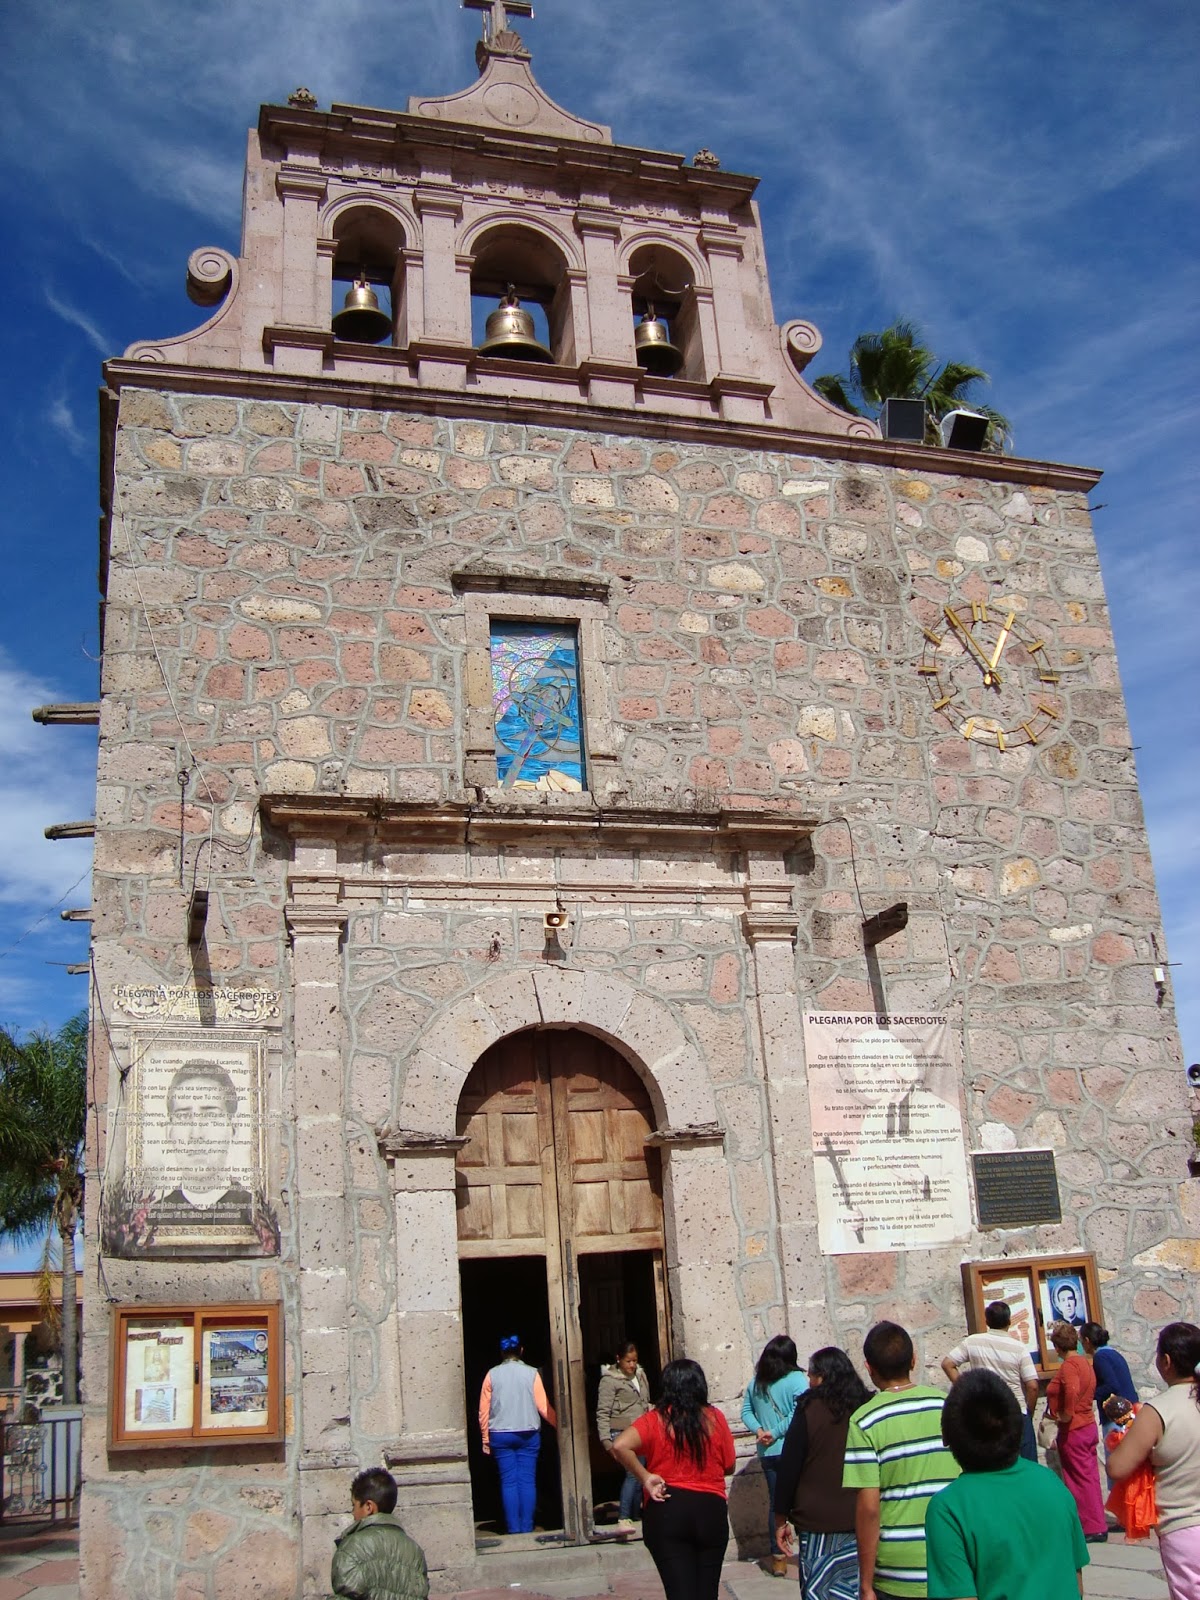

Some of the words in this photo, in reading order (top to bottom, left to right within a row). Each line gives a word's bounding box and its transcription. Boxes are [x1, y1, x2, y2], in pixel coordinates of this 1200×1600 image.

[117, 990, 166, 999] PLEGARIA
[170, 991, 190, 1000] POR
[194, 991, 211, 1000] LOS
[214, 992, 277, 1000] SACERDOTES
[809, 1016, 852, 1025] PLEGARIA
[854, 1016, 873, 1025] POR
[876, 1016, 891, 1025] LOS
[893, 1016, 947, 1025] SACERDOTES
